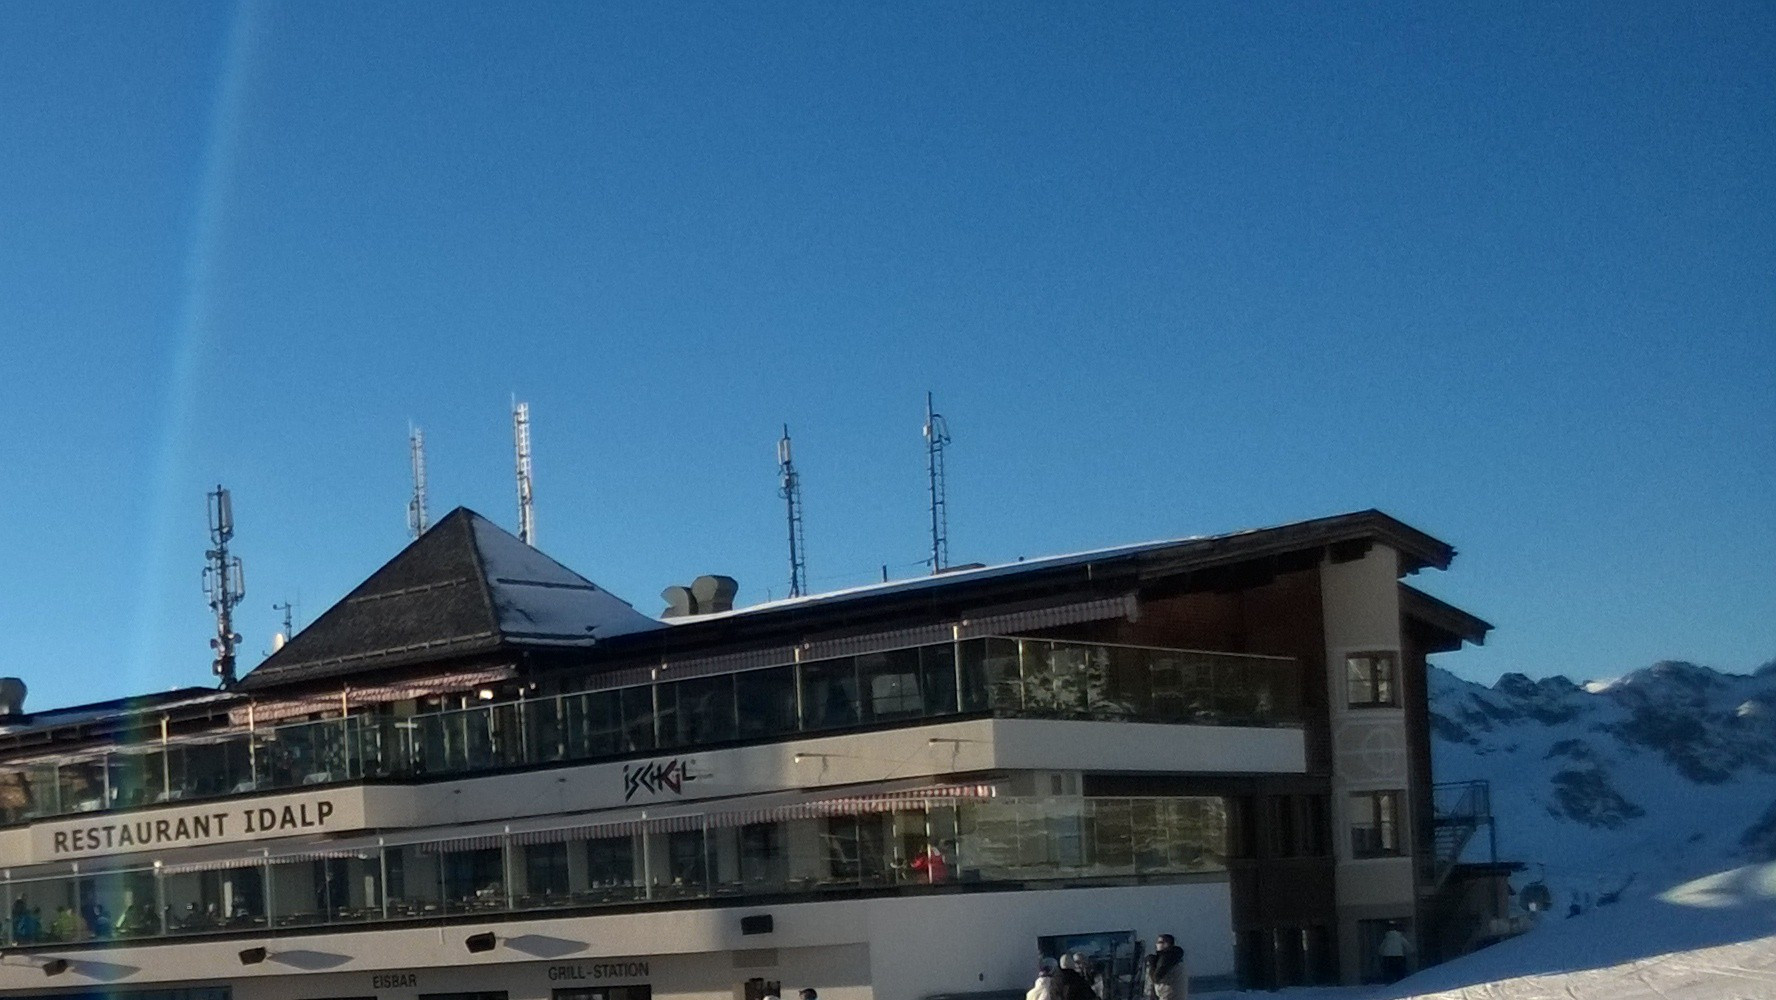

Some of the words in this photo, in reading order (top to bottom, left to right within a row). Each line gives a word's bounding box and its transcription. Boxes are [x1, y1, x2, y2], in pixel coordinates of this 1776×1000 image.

[54, 812, 229, 854] RESTAURANT
[243, 800, 334, 834] IDALP
[372, 973, 418, 989] EISBAR
[547, 961, 650, 981] GRILL-STATION
